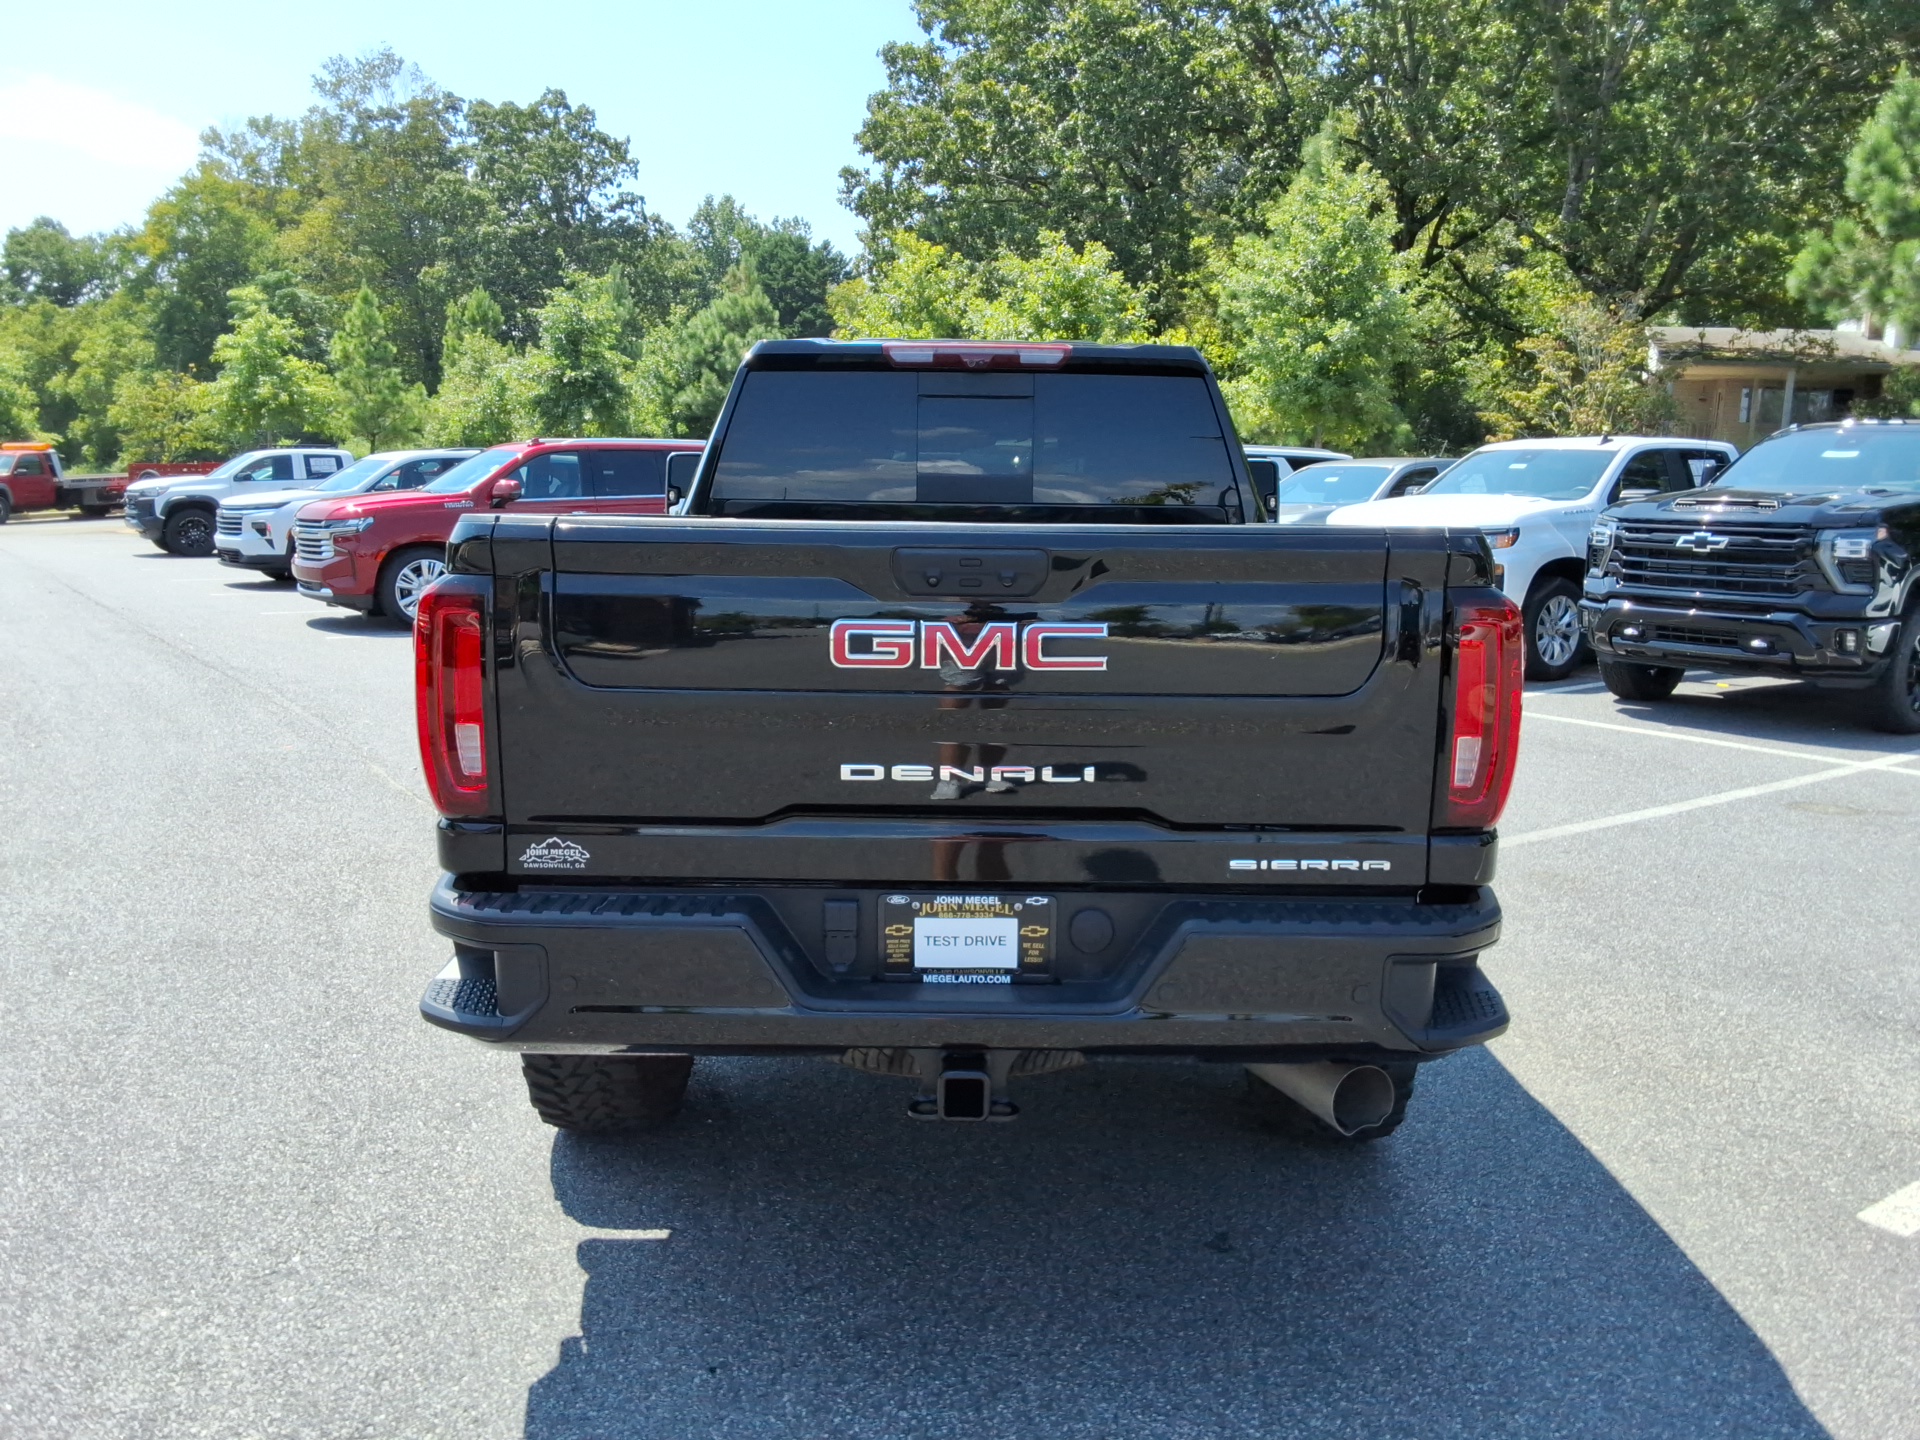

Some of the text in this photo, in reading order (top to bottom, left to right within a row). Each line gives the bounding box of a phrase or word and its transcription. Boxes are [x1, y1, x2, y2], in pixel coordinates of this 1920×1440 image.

[829, 618, 1108, 671] GMC
[840, 764, 1095, 783] DENALI
[526, 849, 581, 858] JOHN MEGEL
[1229, 859, 1391, 871] SIERRA
[934, 896, 1001, 904] JOHN MEGEL
[919, 903, 1013, 916] JOHN MEGEL
[924, 936, 1006, 946] TEST DRIVE
[923, 975, 1011, 983] MEGELAUTO.COM
